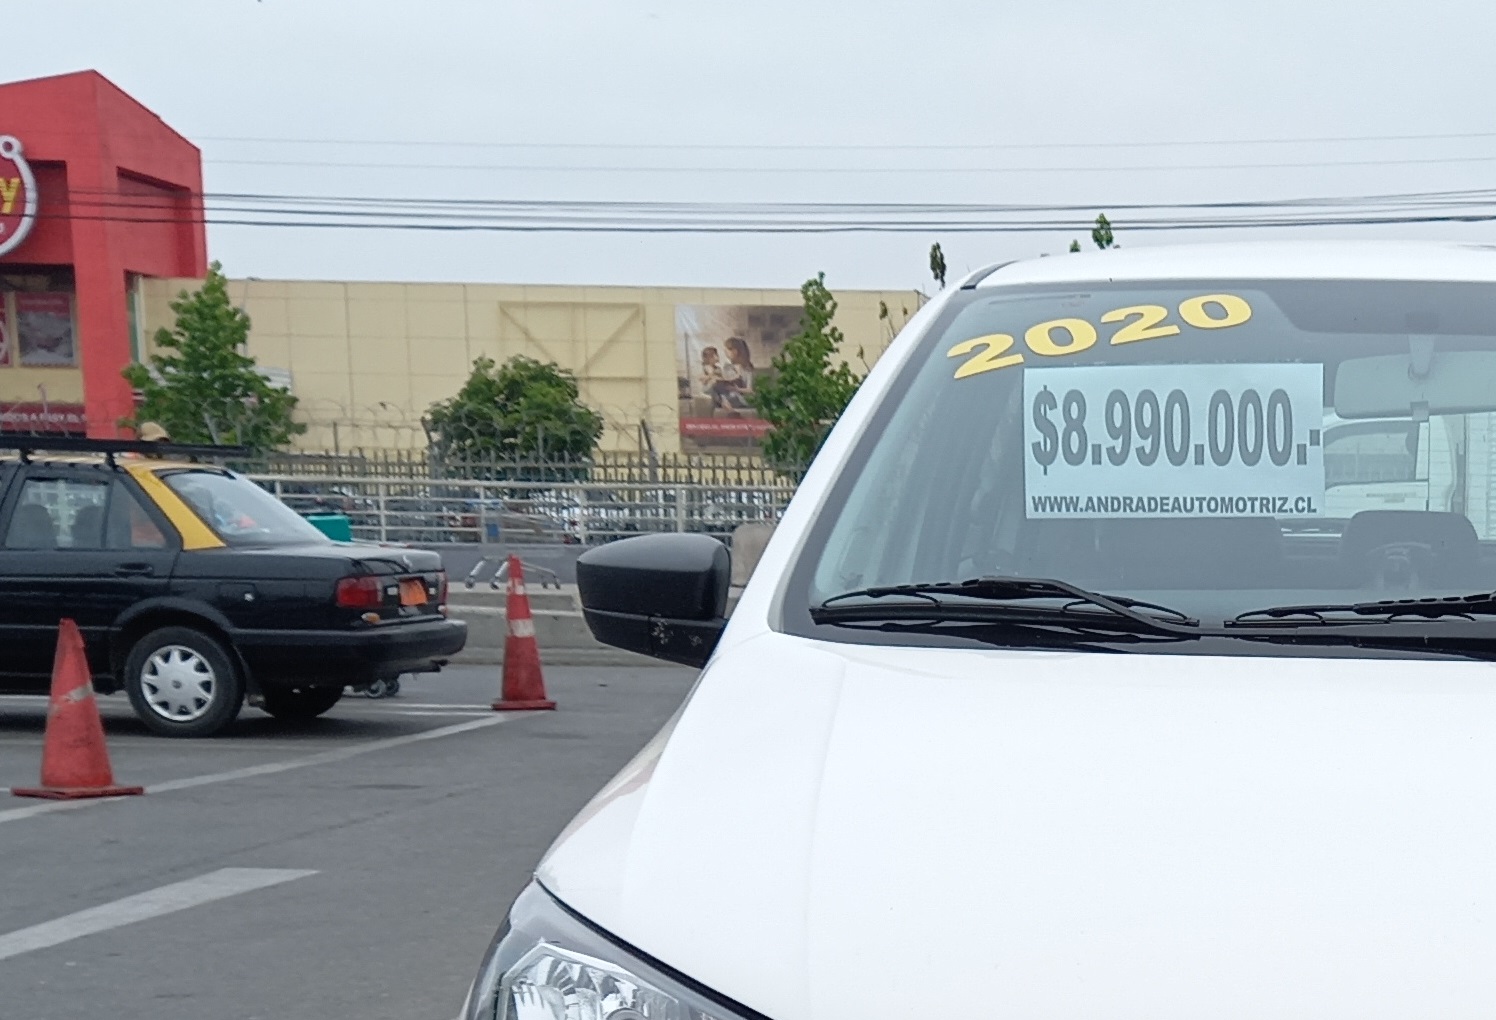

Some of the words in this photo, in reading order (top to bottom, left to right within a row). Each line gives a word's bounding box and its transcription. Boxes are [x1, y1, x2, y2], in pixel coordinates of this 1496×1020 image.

[947, 293, 1253, 379] 2020
[1031, 385, 1321, 476] $8.990.000.-
[1032, 495, 1317, 514] WWW.ANDRADEAUTOMOTRIZ.CL
